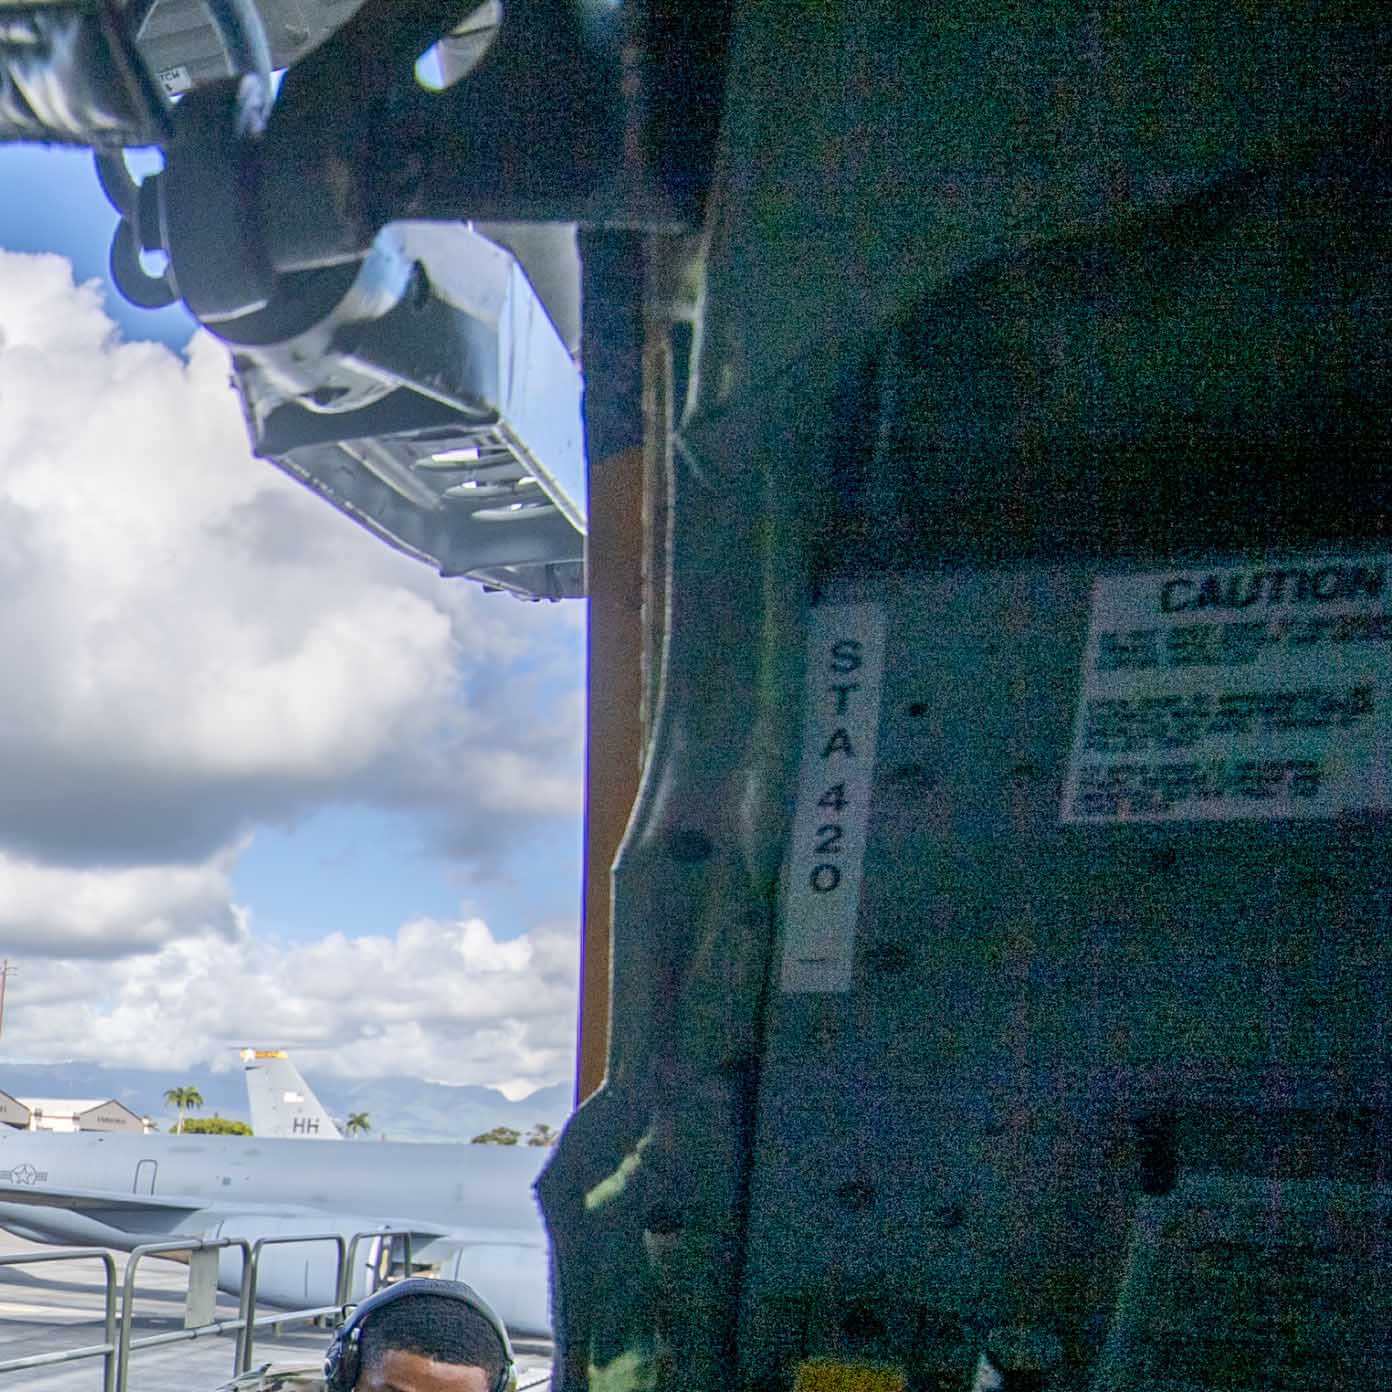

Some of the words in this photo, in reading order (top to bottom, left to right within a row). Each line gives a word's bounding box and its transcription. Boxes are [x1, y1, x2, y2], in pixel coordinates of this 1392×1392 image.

[1160, 563, 1385, 612] CAUTION
[821, 639, 862, 759] STA
[809, 783, 849, 894] 420
[292, 1117, 320, 1134] HH
